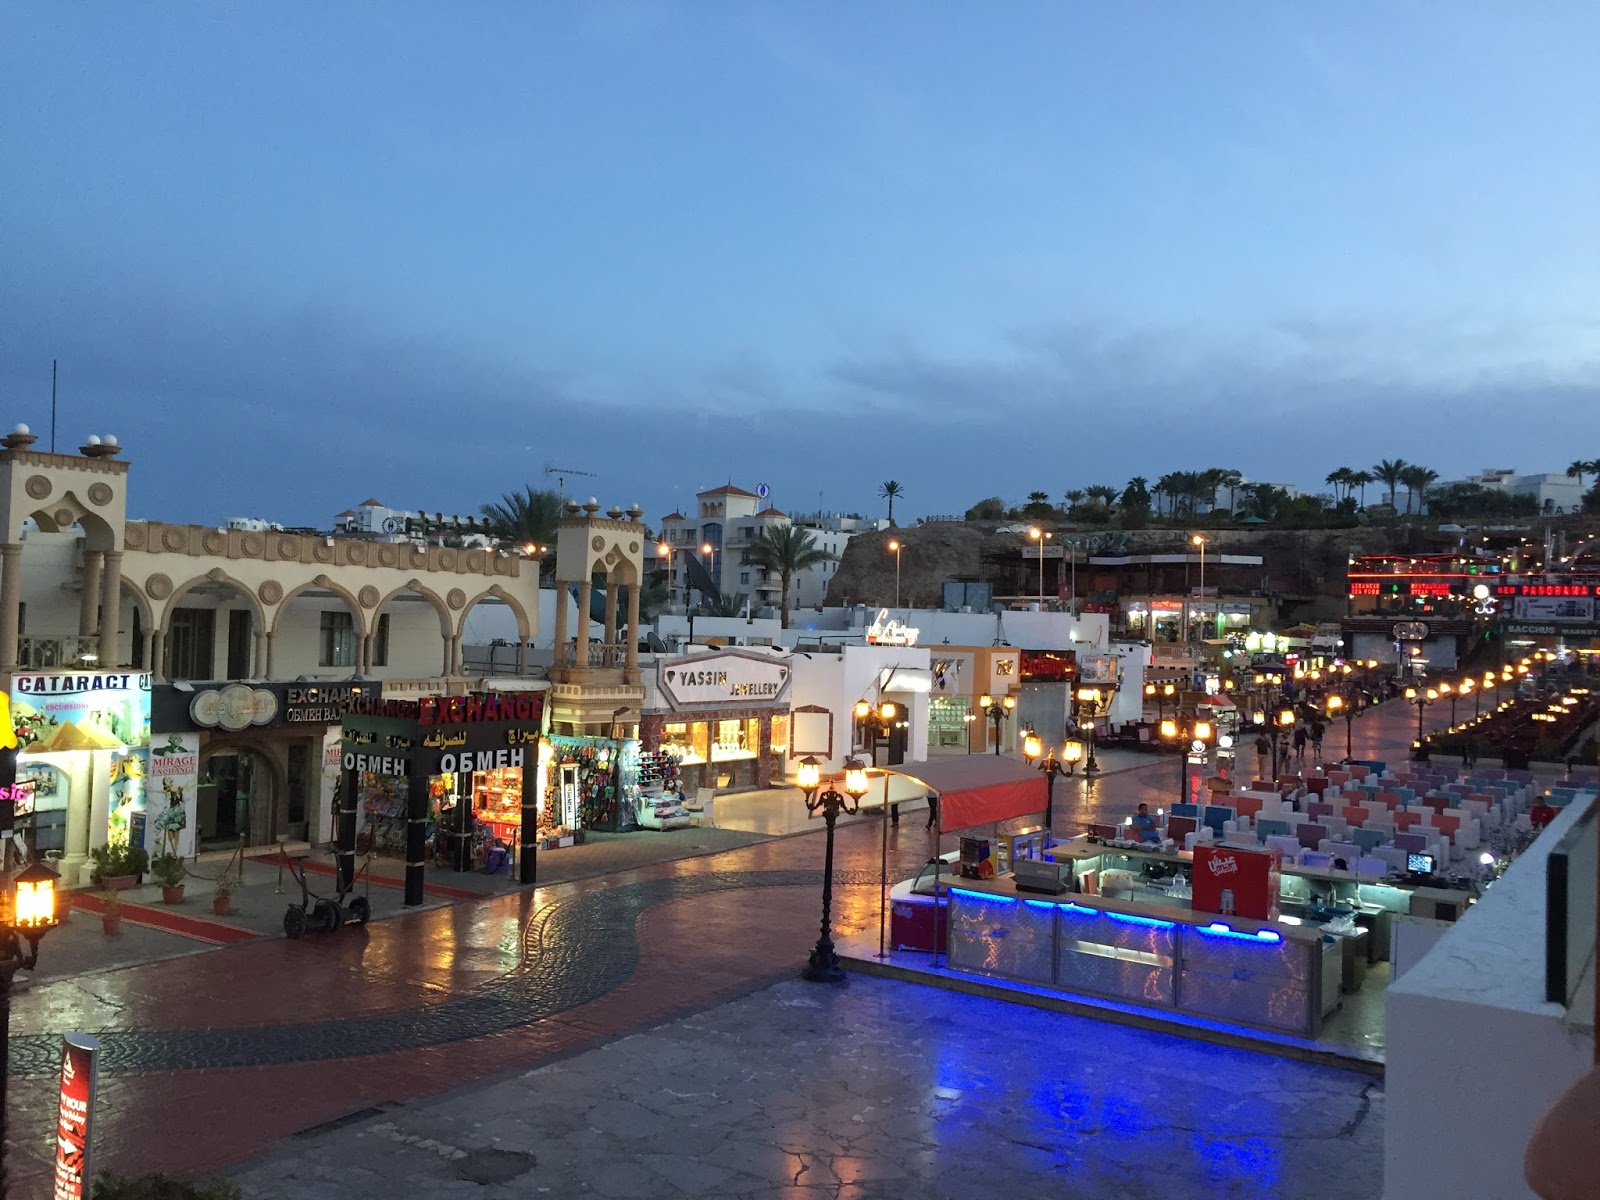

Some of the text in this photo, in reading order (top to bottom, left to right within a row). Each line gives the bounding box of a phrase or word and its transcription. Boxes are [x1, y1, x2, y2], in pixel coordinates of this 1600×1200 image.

[1522, 585, 1589, 596] PANORAMA
[17, 675, 130, 692] CATARACT
[680, 671, 727, 686] YASSIN
[287, 687, 371, 704] EXCHANGE
[730, 683, 778, 696] JEWELLERY
[286, 707, 322, 722] ОБМЕН
[418, 692, 544, 725] EXCHANGE
[153, 756, 196, 768] MIRAGE
[344, 752, 405, 776] ОБМЕН
[440, 748, 524, 774] ОБМЕН
[152, 766, 196, 776] EXCHANGE
